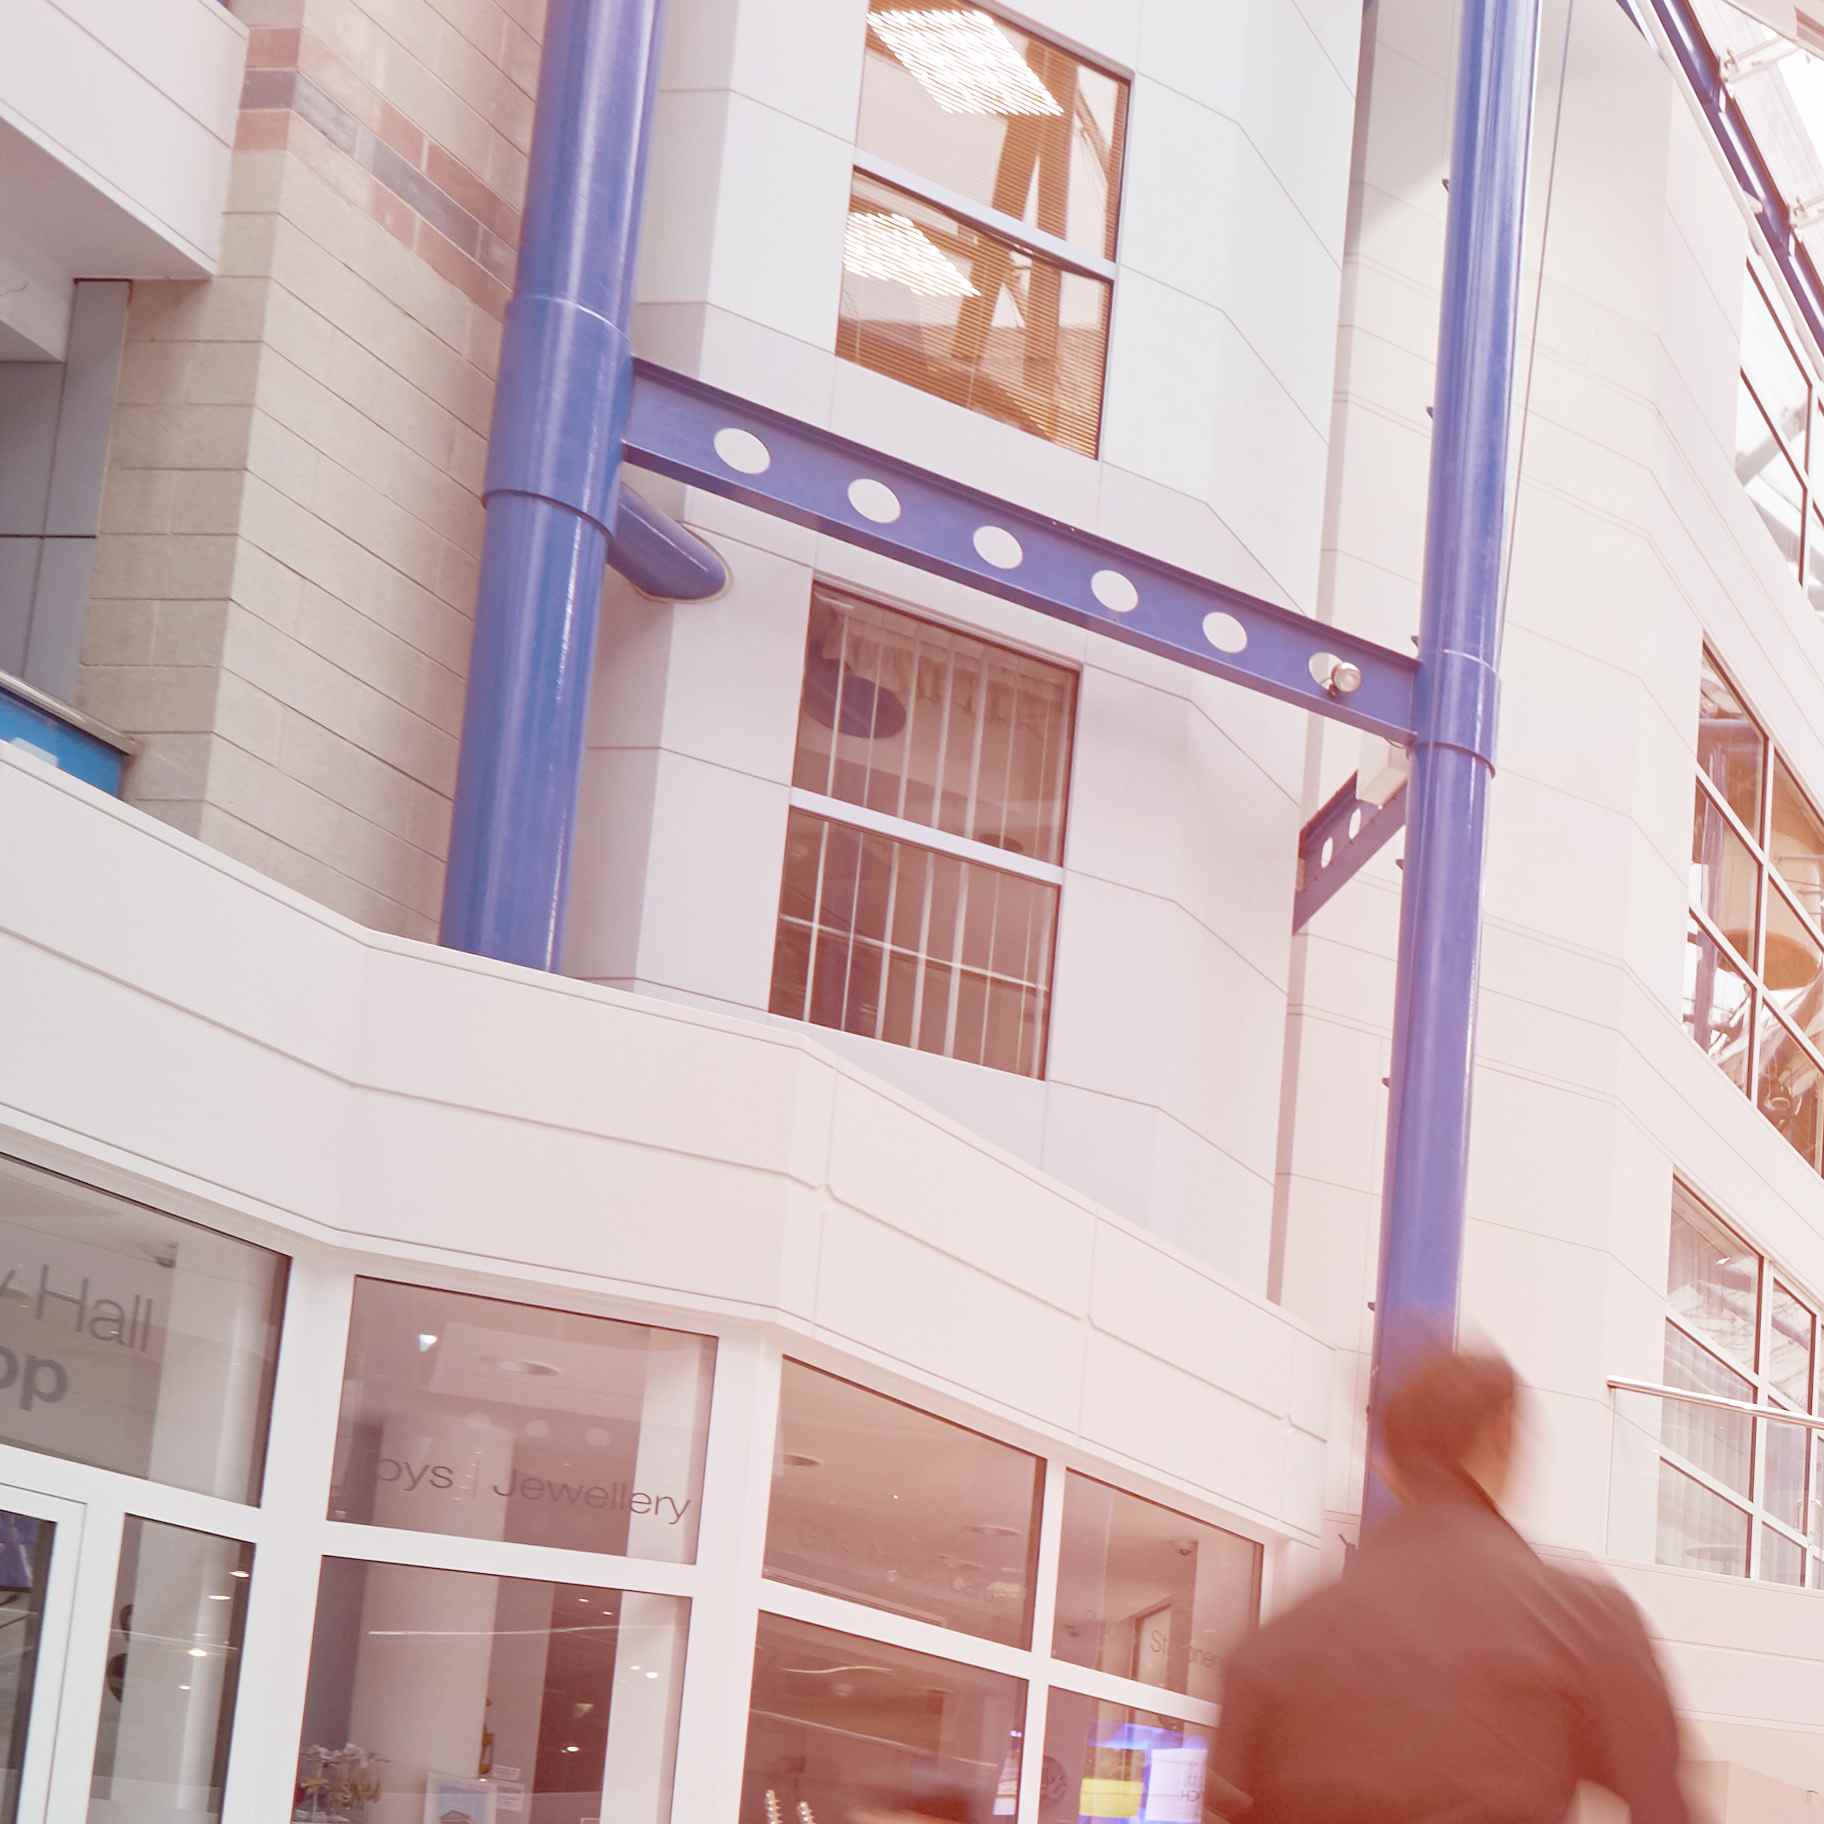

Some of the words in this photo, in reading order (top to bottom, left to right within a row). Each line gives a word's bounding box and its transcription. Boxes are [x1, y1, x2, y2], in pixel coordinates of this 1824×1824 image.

[35, 1263, 153, 1352] Hall
[376, 1457, 455, 1492] oys
[493, 1468, 692, 1526] Jewellery
